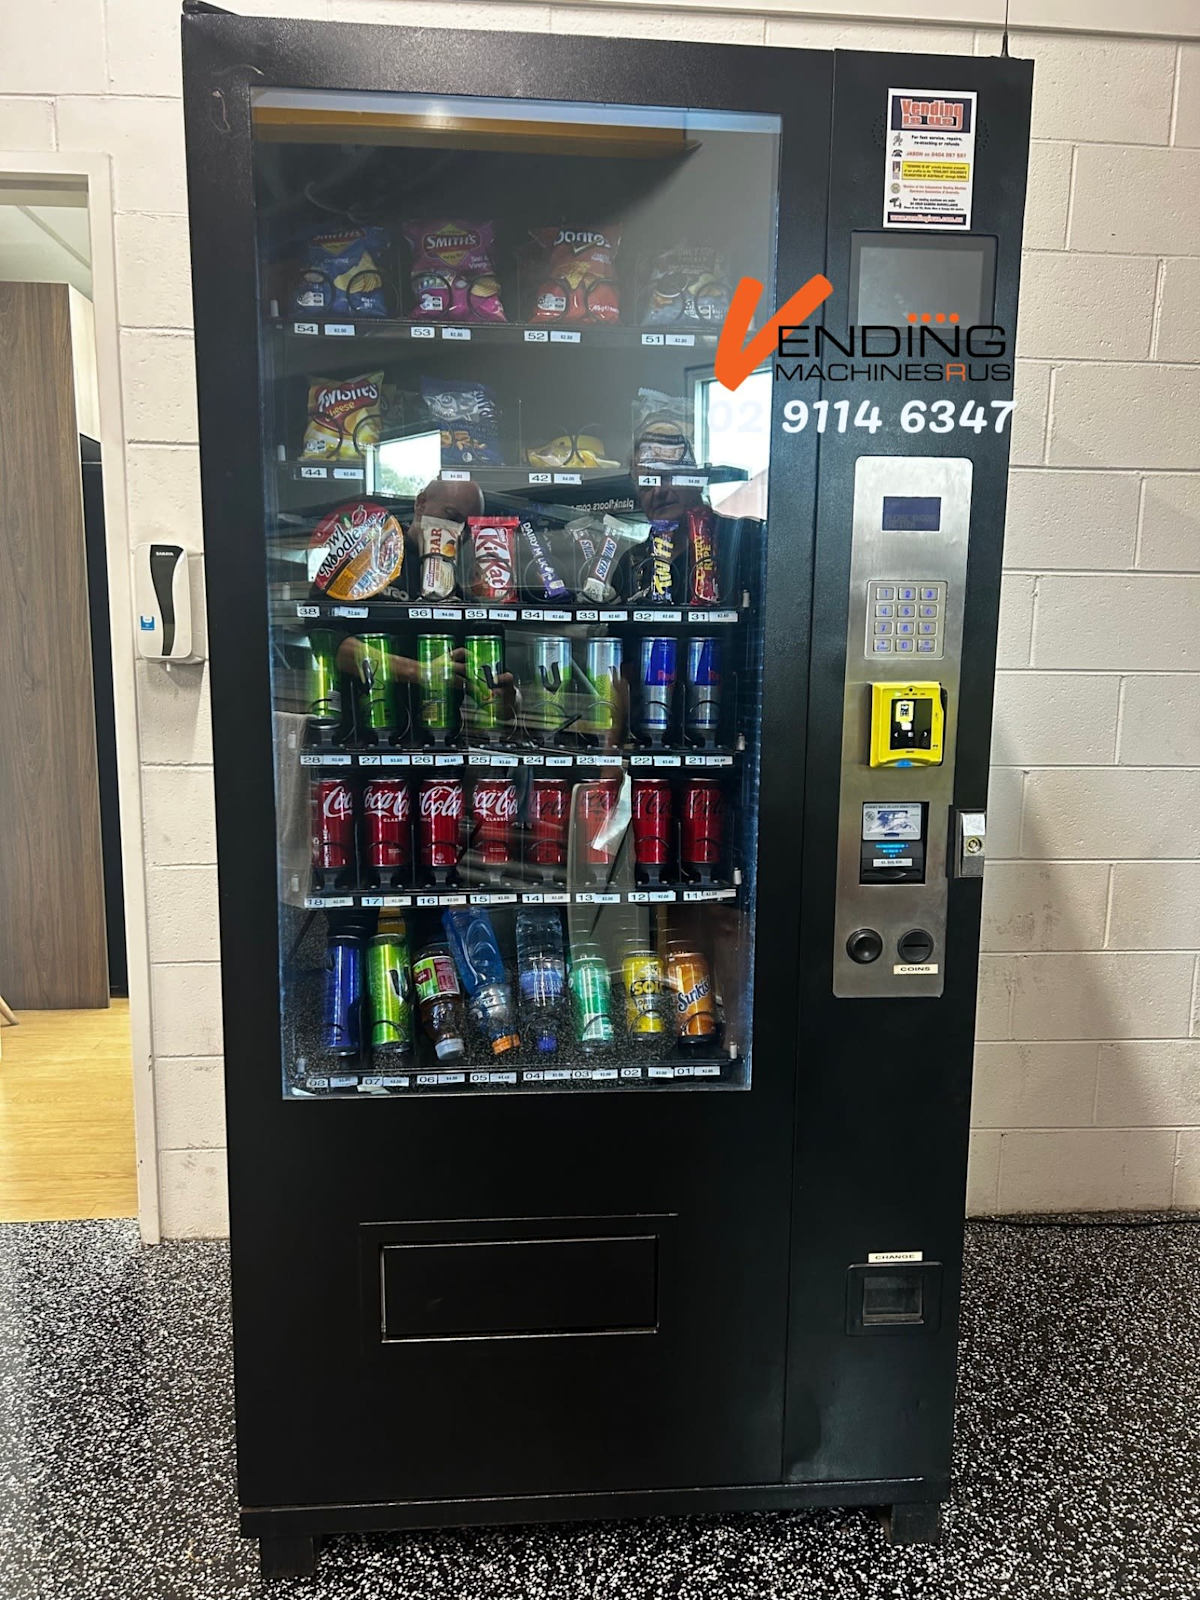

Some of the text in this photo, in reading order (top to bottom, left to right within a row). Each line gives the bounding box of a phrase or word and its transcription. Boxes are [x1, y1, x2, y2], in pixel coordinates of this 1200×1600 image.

[900, 98, 964, 122] Vending
[426, 234, 477, 249] SMITH'S
[553, 231, 612, 248] orito
[296, 324, 315, 334] 54
[413, 328, 432, 337] 53
[527, 332, 545, 341] 52
[645, 335, 661, 344] 51
[305, 469, 321, 477] 44
[325, 524, 345, 549] owl
[430, 528, 442, 554] BAR
[523, 521, 549, 569] DAIRY MLK
[318, 529, 360, 576] Noodle
[597, 539, 616, 578] SNIKERS
[703, 544, 712, 571] RIPE
[299, 608, 316, 616] 38
[410, 609, 428, 618] 36
[467, 610, 484, 618] 35
[524, 611, 541, 620] 34
[579, 611, 596, 620] 33
[635, 612, 652, 621] 32
[691, 613, 706, 621] 31
[303, 756, 321, 764] 28
[414, 756, 431, 764] 26
[471, 756, 488, 764] 25
[579, 756, 595, 764] 23
[308, 898, 323, 906] 18
[525, 895, 540, 903] 14
[471, 1074, 488, 1082] 05
[525, 1072, 541, 1080] 04
[574, 1071, 590, 1079] 03
[309, 1079, 326, 1087] 08
